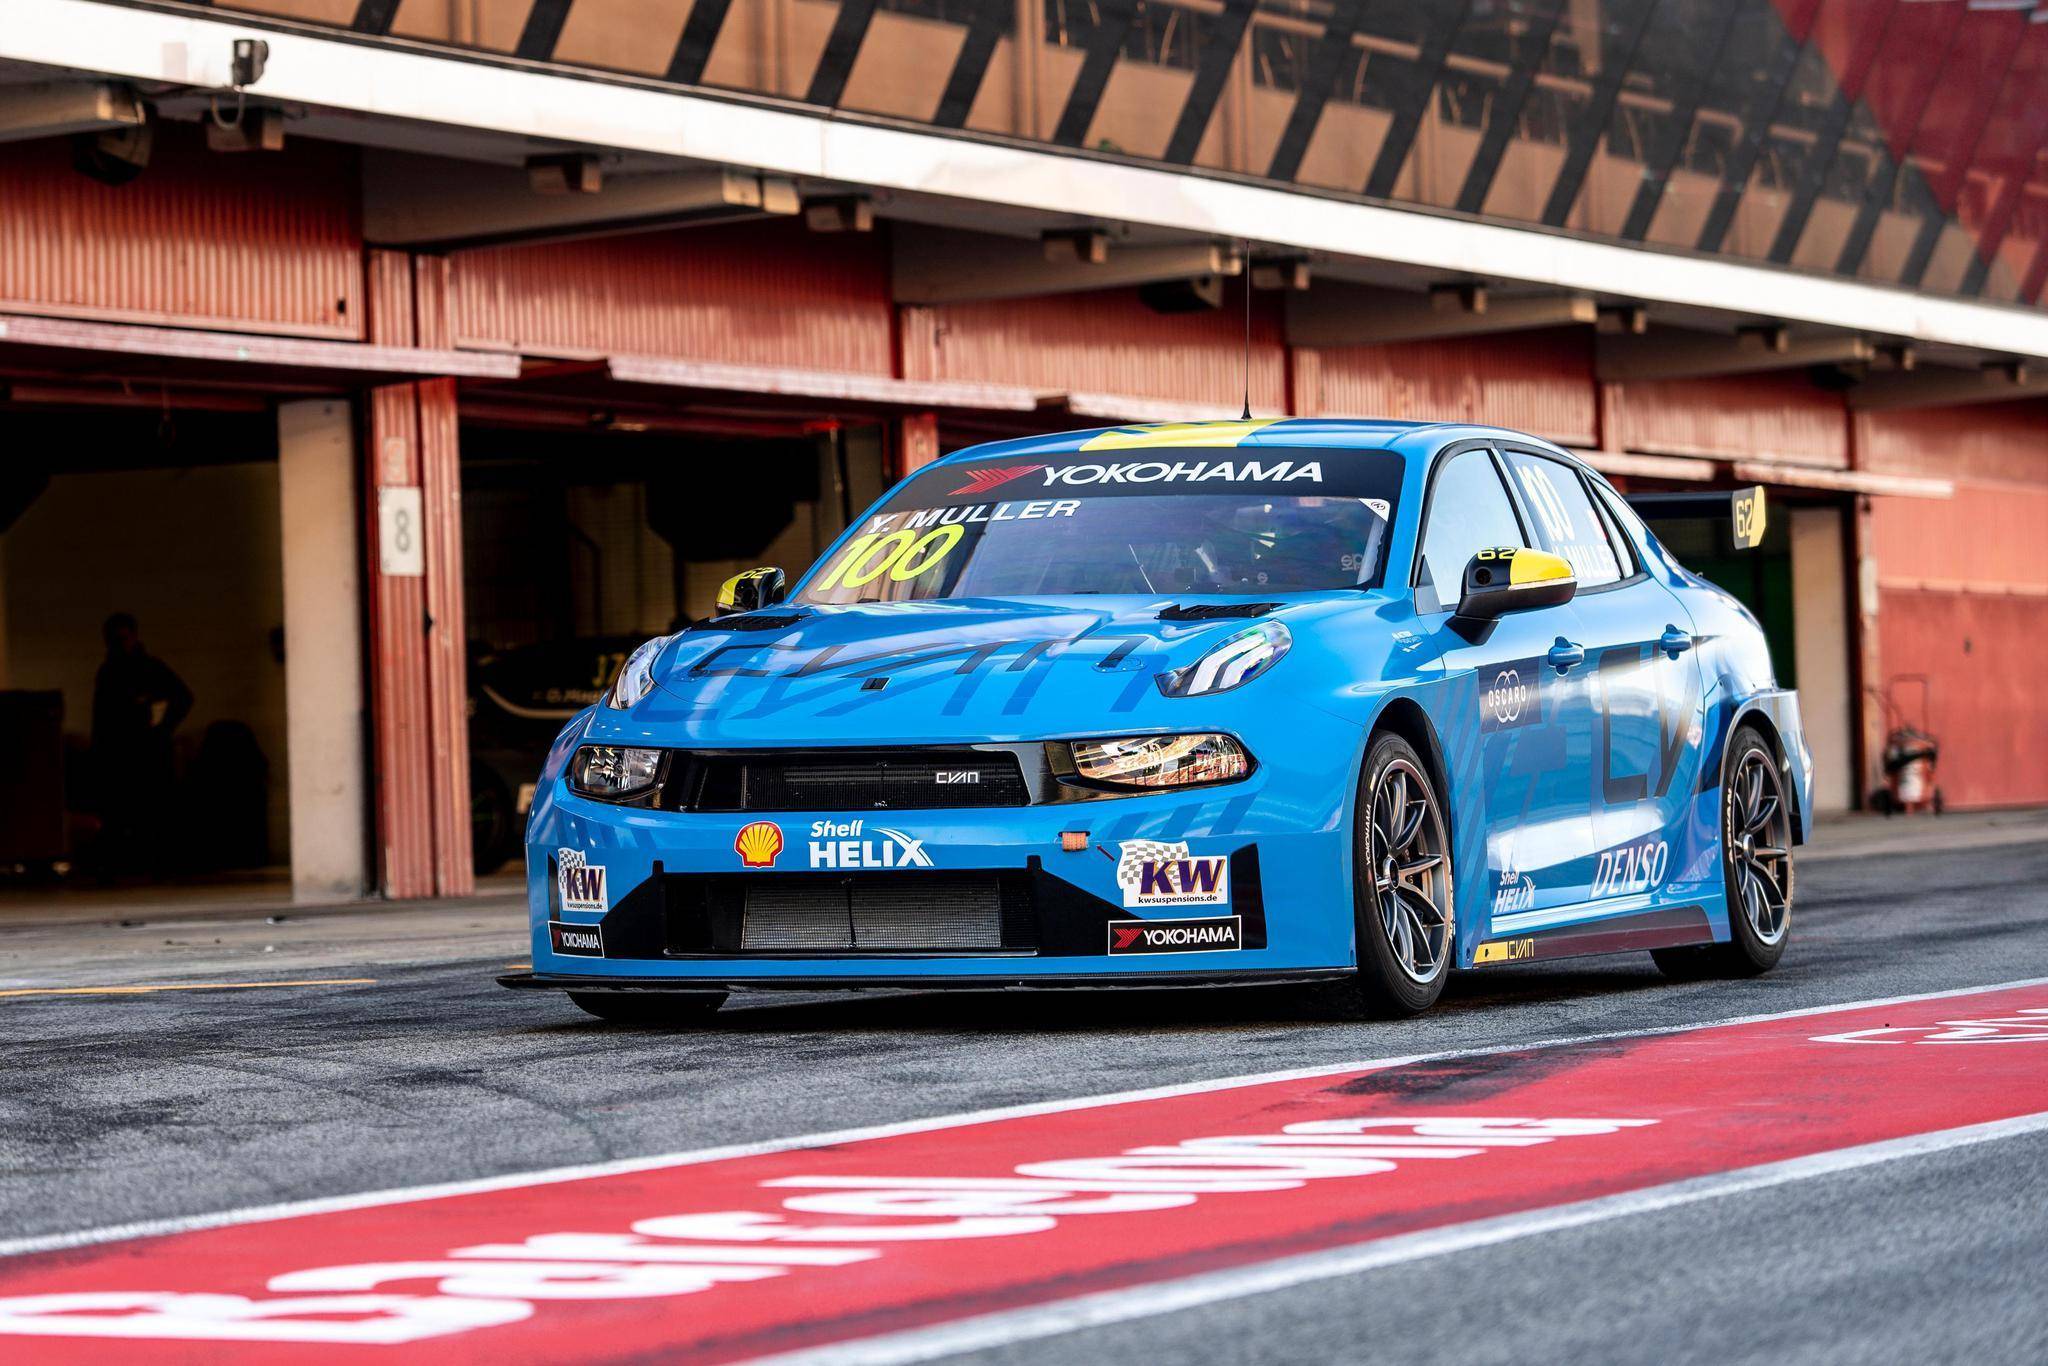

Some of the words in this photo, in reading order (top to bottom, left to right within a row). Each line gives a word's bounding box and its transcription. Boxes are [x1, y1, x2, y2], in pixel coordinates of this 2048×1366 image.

[1042, 461, 1323, 487] YOKOHAMA
[395, 509, 410, 552] 8
[868, 514, 897, 533] Y.
[905, 500, 1081, 529] MULLER
[1736, 498, 1753, 538] 62
[817, 524, 965, 592] 100
[1477, 546, 1516, 560] 62
[1487, 683, 1527, 708] OSCARO
[811, 820, 864, 838] Shell
[809, 828, 936, 868] HELIX
[566, 867, 602, 901] KW
[1140, 858, 1227, 895] KW
[1500, 865, 1520, 886] Shell
[1592, 840, 1669, 898] DENSO
[1137, 894, 1218, 904] kwsuspensions.de
[1493, 876, 1536, 914] HELIX
[560, 931, 601, 950] YOKOHAMA
[1143, 926, 1236, 946] YOKOHAMA
[0, 1115, 1660, 1345] Barcelona
